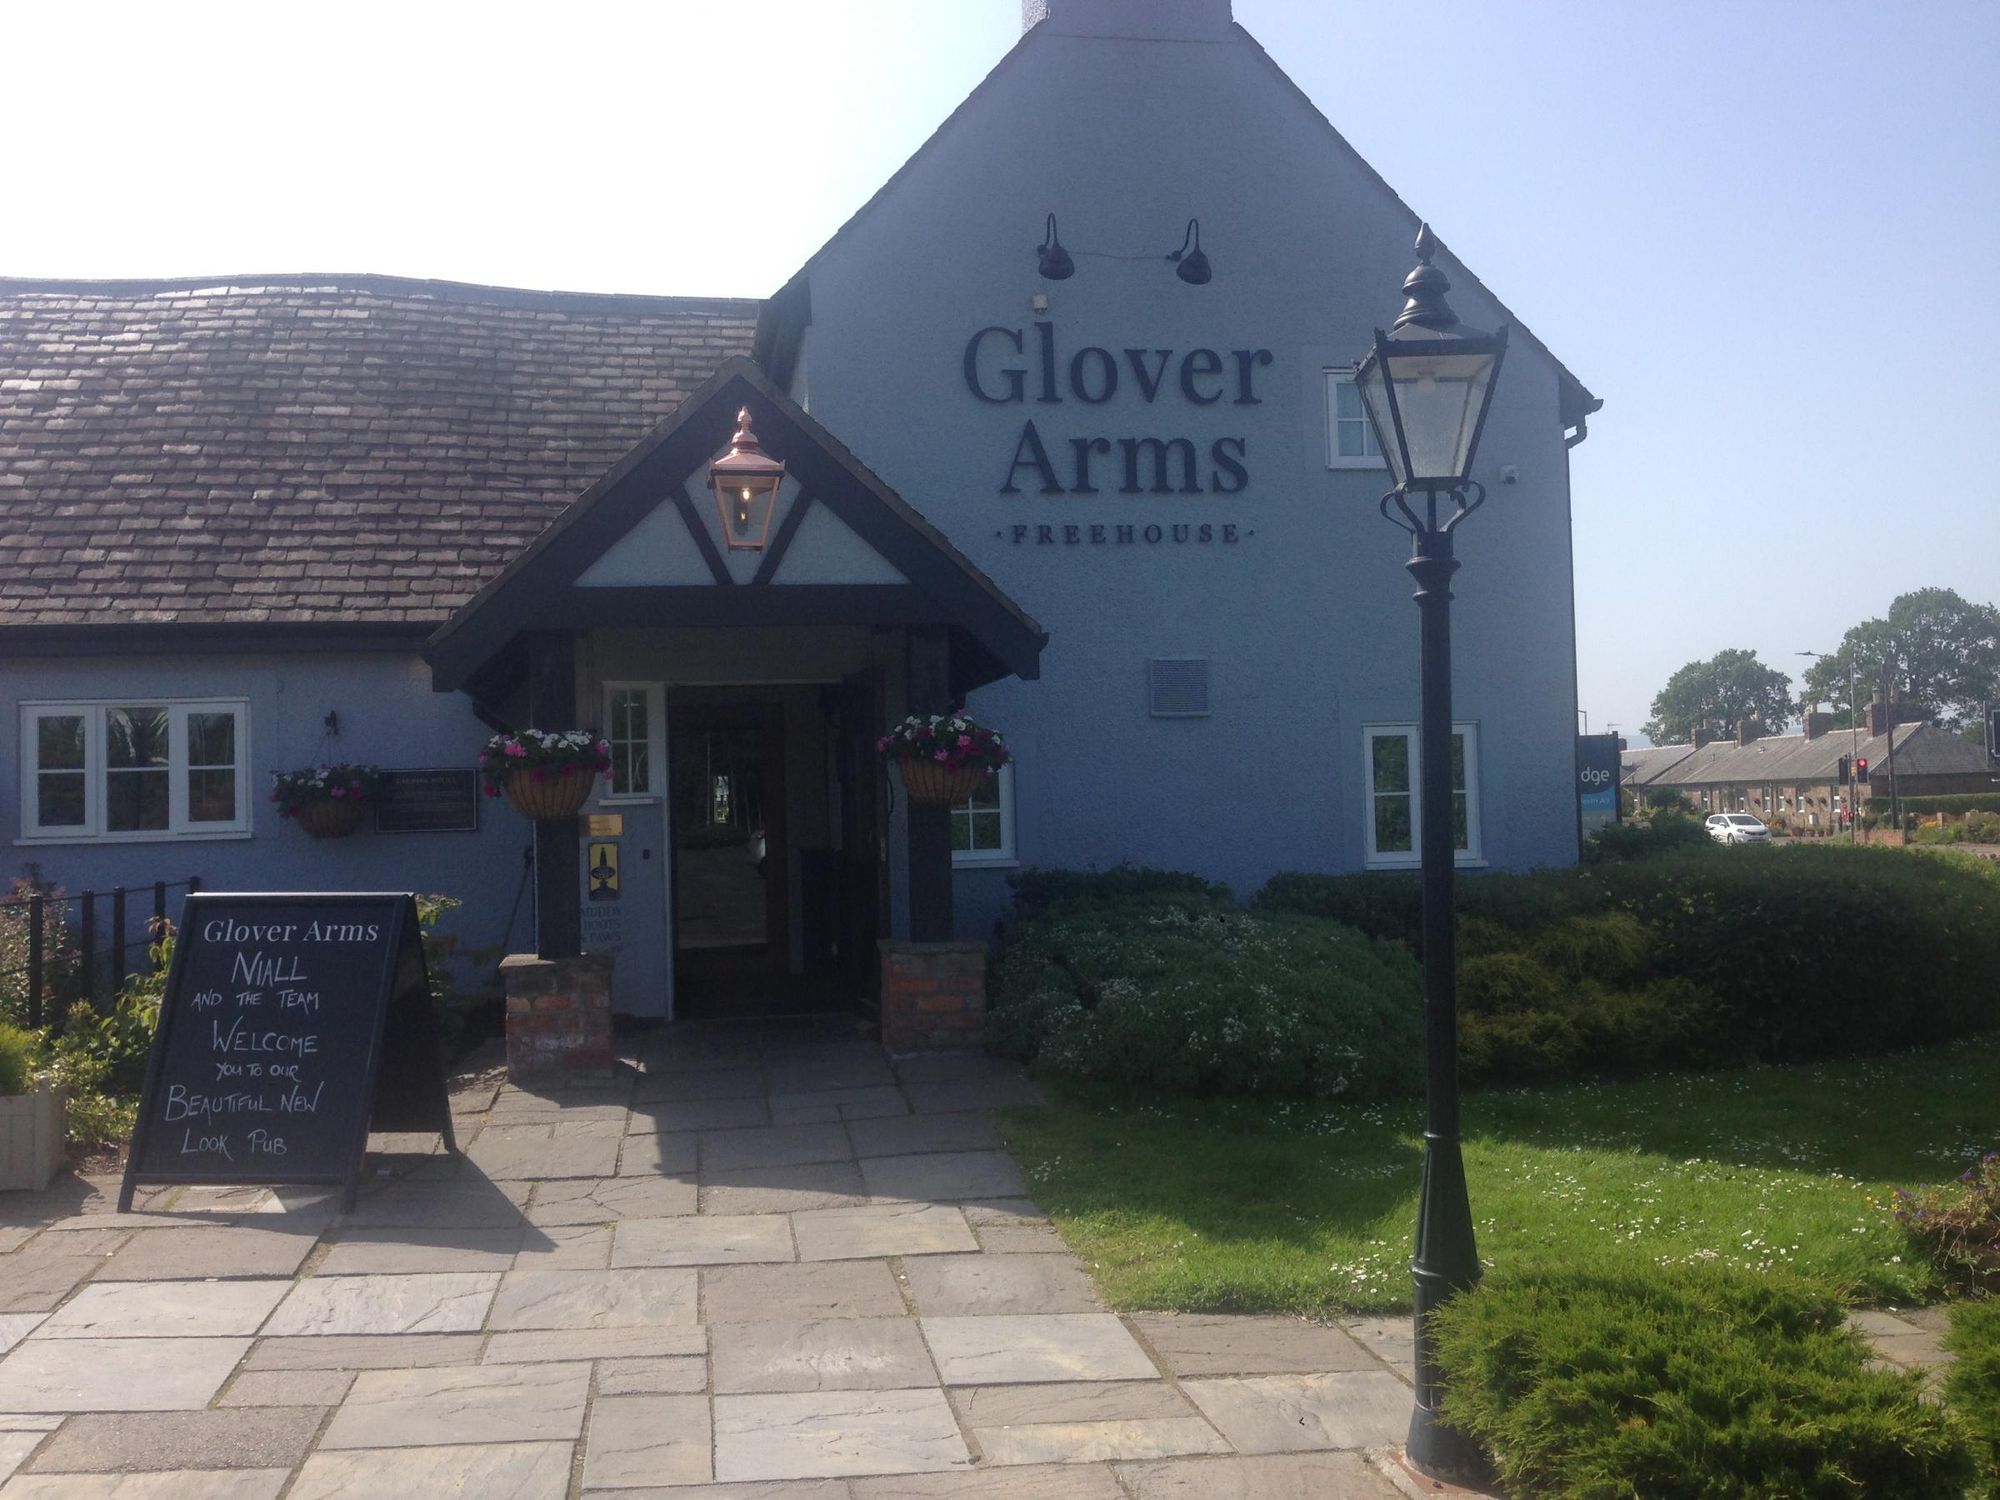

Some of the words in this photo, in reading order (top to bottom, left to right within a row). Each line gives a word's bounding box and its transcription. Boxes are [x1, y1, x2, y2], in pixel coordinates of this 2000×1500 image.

[963, 321, 1273, 405] Glover
[1000, 418, 1249, 495] Arms
[1012, 524, 1239, 545] FREEHOUSE
[204, 920, 297, 943] Glover
[302, 920, 379, 943] Arms
[231, 951, 308, 987] NIALL
[190, 989, 223, 1014] AND
[236, 992, 262, 1007] THE
[280, 990, 319, 1016] TEAM
[212, 1015, 319, 1059] WELCOME
[164, 1084, 273, 1127] BEAUTIFUL
[280, 1081, 325, 1114] NEW
[181, 1128, 234, 1161] LOOK
[248, 1129, 288, 1156] PUB
